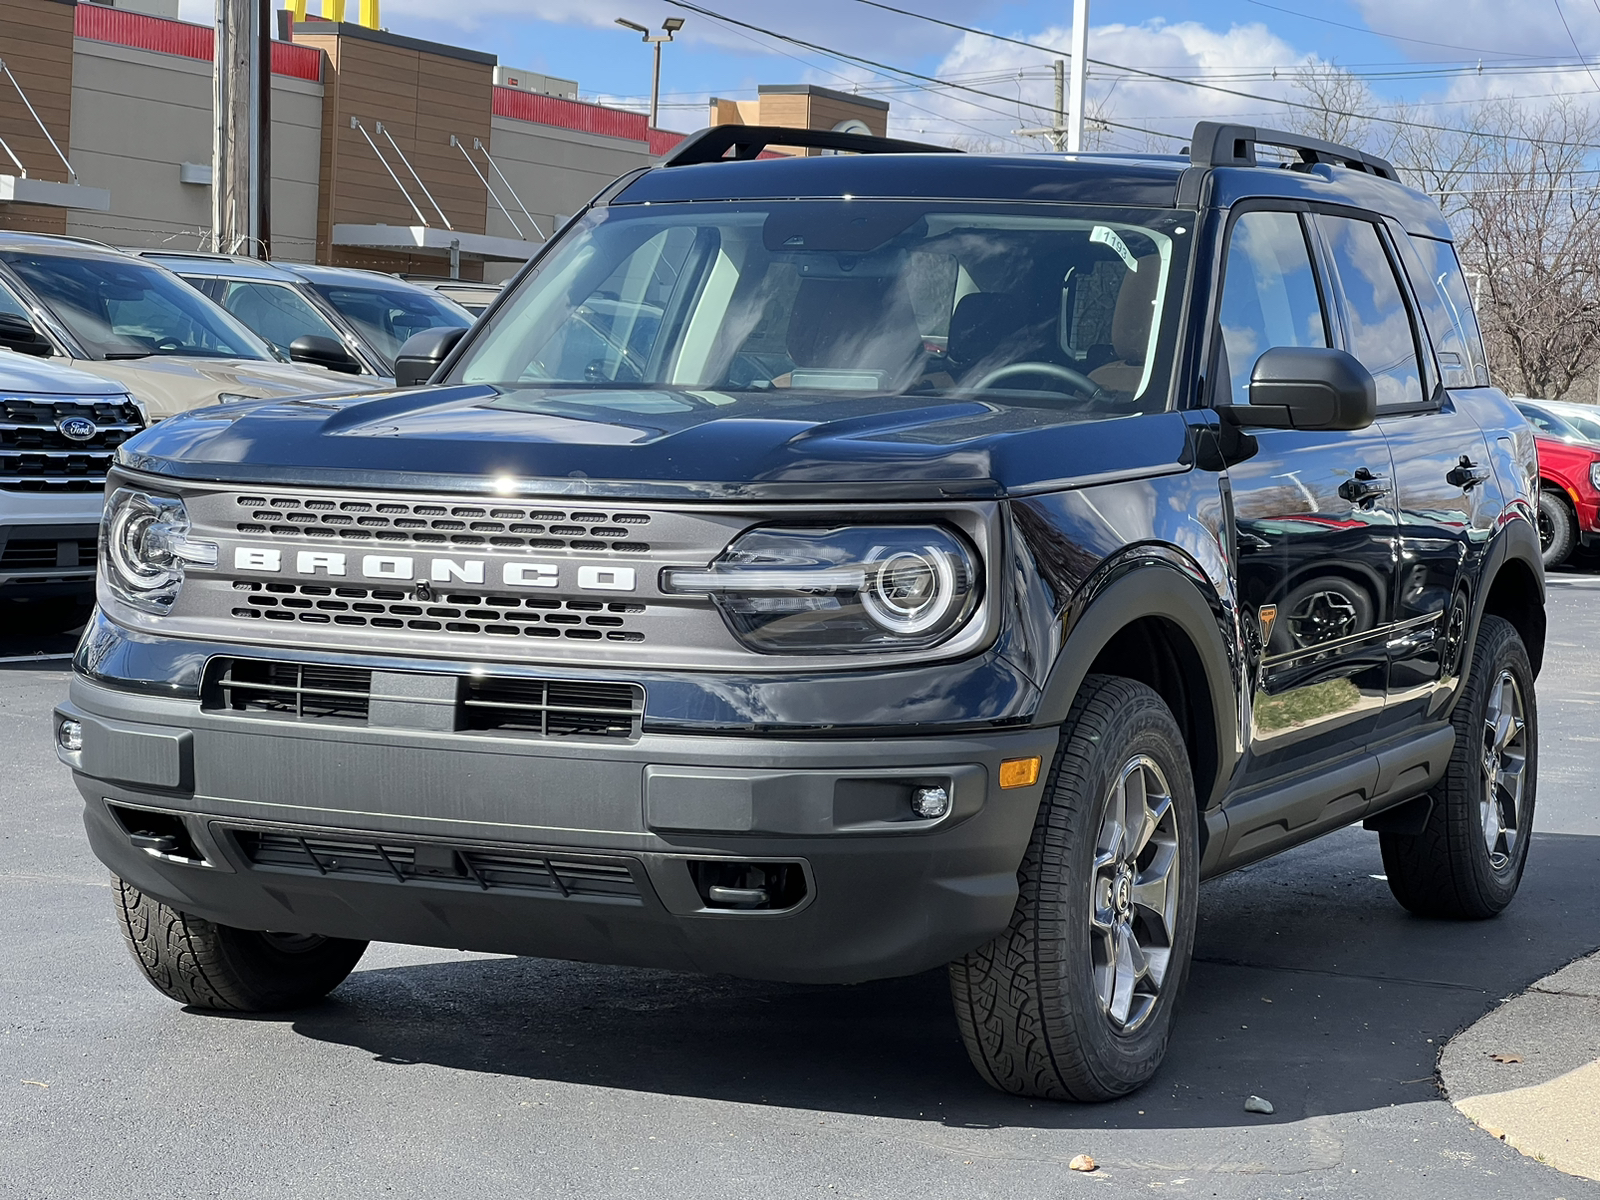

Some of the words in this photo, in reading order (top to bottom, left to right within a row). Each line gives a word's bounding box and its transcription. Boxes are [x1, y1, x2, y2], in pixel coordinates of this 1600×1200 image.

[1103, 231, 1128, 259] 1193
[70, 421, 90, 435] Ford
[234, 547, 636, 591] BRONCO
